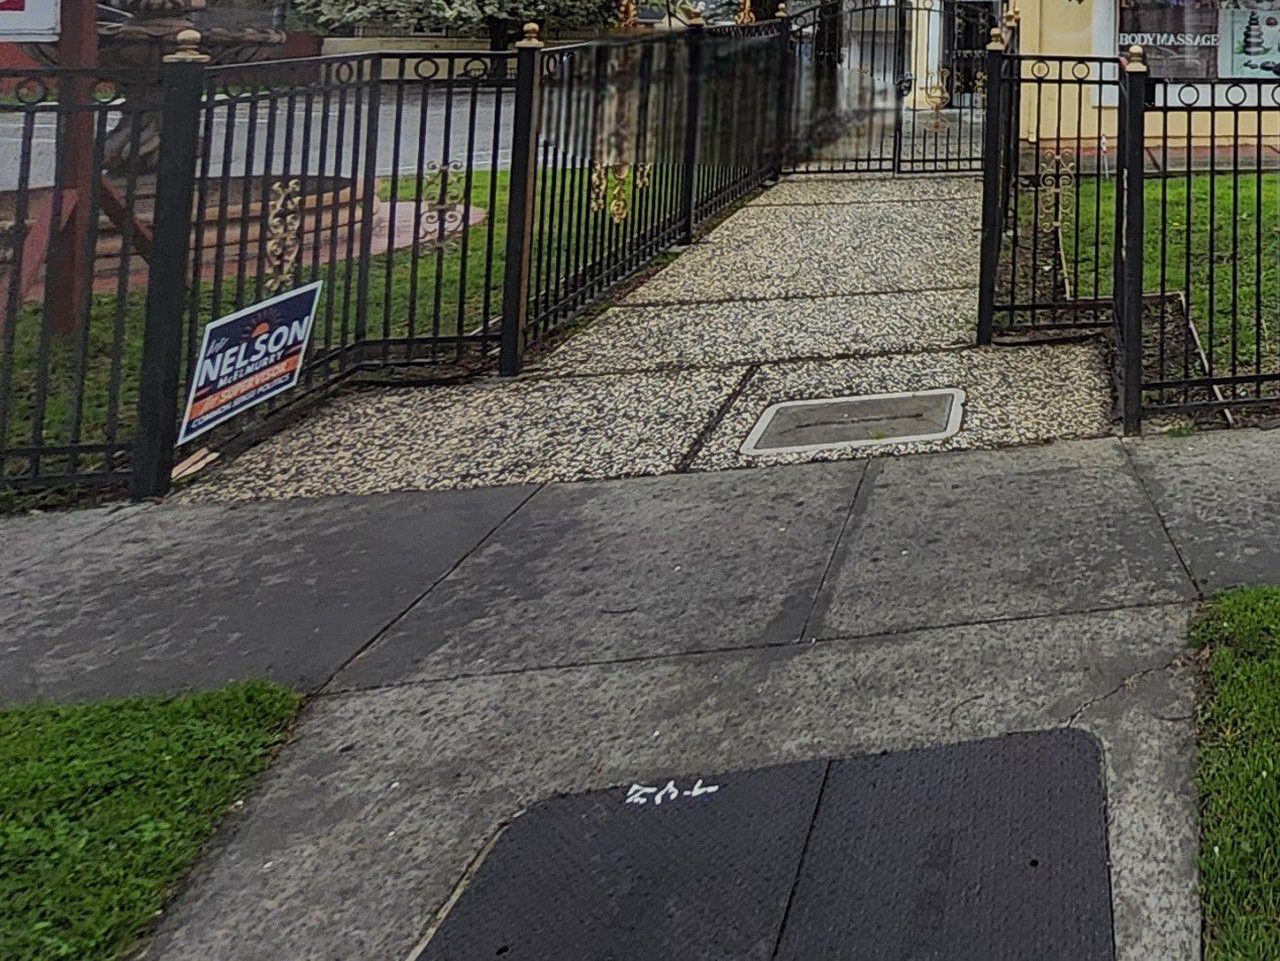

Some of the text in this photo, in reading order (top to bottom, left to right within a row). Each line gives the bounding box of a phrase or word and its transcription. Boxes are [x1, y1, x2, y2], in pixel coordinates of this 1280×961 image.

[1119, 32, 1220, 46] BODY MASSAGE
[198, 316, 309, 387] NELSON
